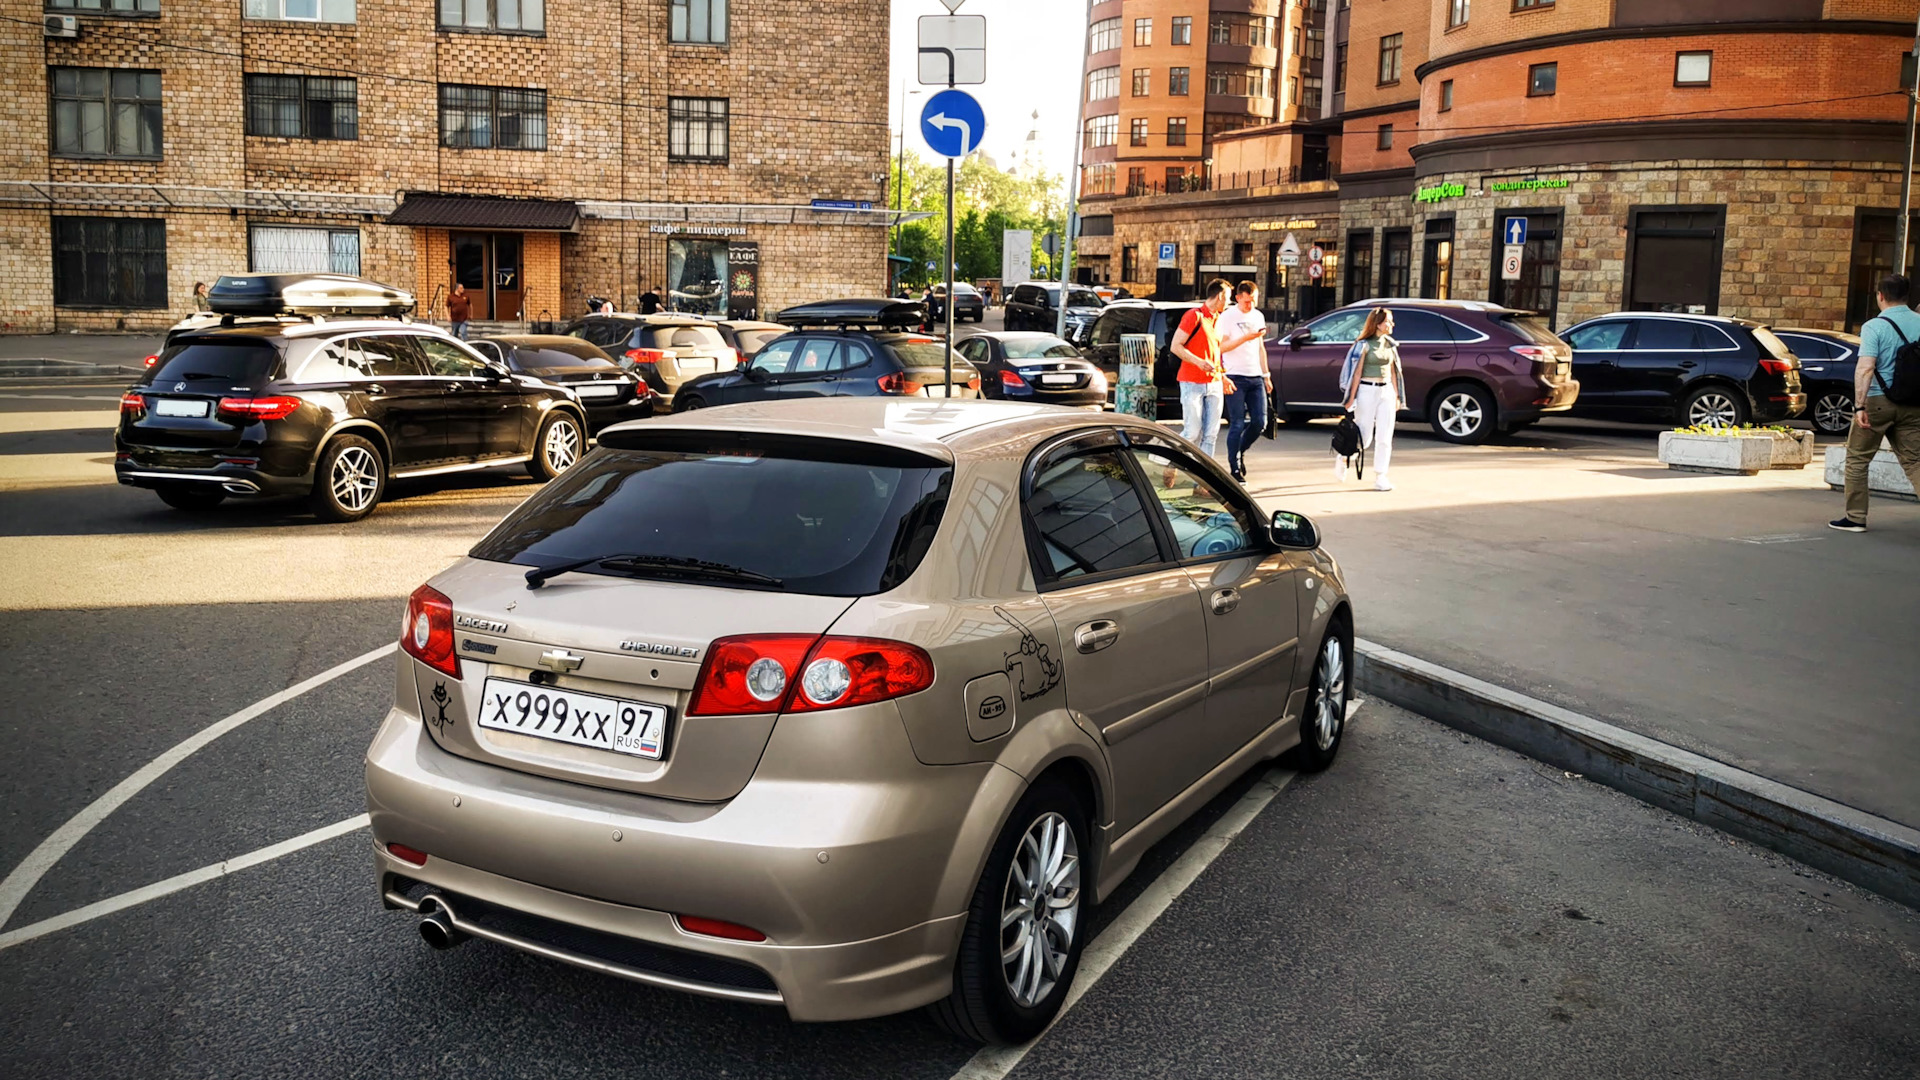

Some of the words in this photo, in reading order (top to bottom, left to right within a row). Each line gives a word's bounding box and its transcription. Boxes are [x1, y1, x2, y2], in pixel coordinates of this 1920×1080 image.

[1491, 179, 1569, 192] кондитерская
[686, 226, 747, 237] пиццерия
[729, 251, 757, 261] КАФЕ
[1163, 246, 1171, 258] P
[1509, 260, 1516, 271] 5
[620, 640, 700, 658] CHEVROLET
[621, 707, 653, 738] 97
[616, 735, 640, 749] RUS
